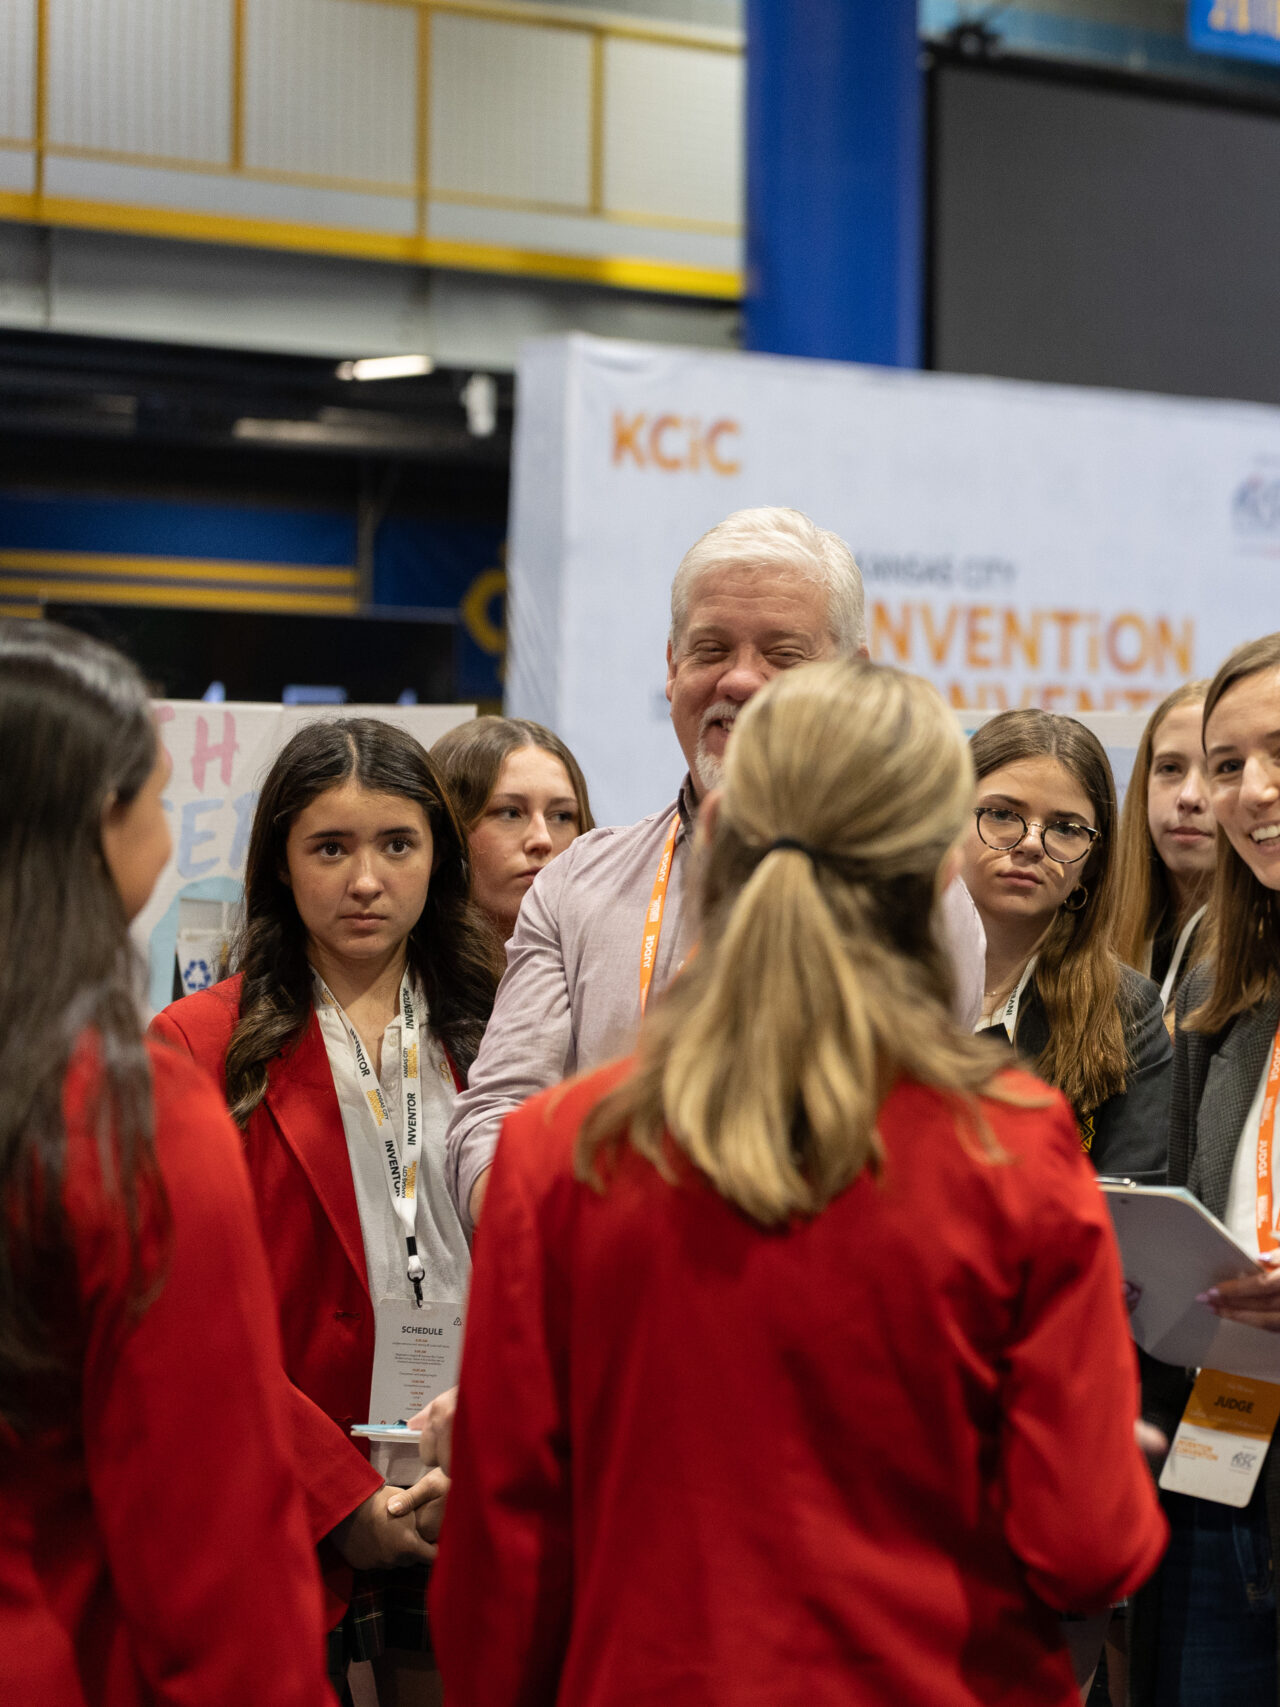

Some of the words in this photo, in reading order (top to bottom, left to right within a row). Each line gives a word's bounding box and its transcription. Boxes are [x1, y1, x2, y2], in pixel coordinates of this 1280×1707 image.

[960, 557, 1016, 589] CITY
[643, 934, 656, 969] JUDGE
[349, 1027, 371, 1078] INVENTOR
[406, 1092, 417, 1146] INVENTOR
[1257, 1139, 1269, 1179] JUDGE
[401, 1326, 443, 1336] SCHEDULE
[1214, 1396, 1254, 1414] JUDGE
